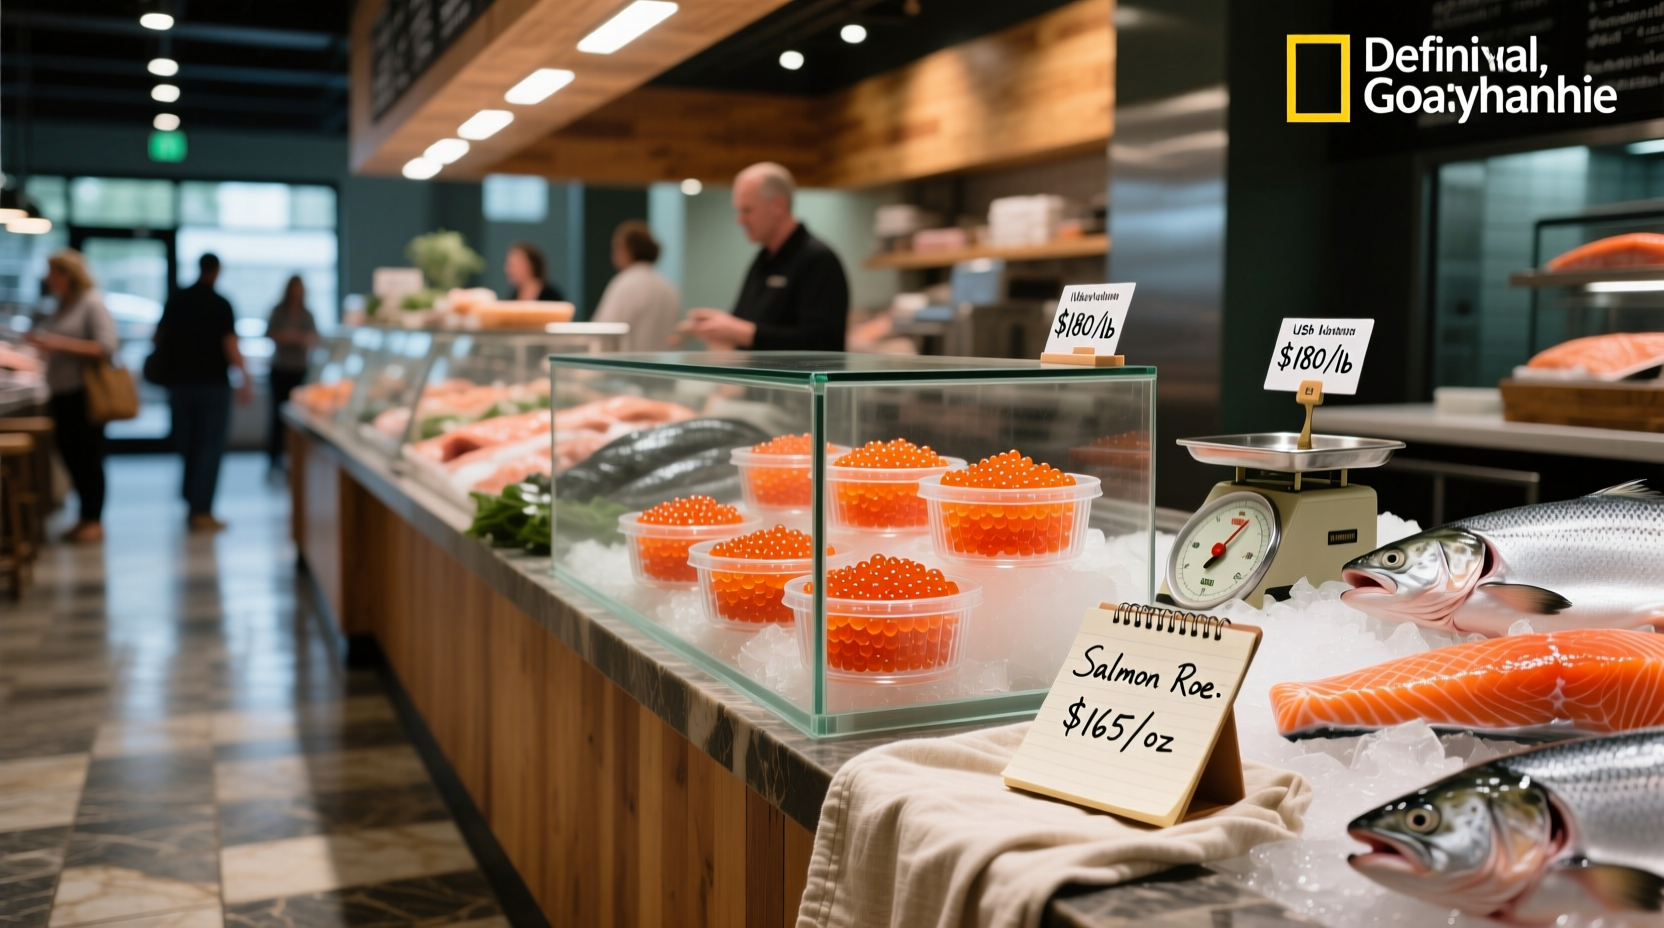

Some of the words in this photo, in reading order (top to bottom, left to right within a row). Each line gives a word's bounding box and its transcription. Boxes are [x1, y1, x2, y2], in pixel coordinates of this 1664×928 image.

[1054, 308, 1115, 339] $180/lb
[1277, 341, 1353, 374] $180/lb
[1072, 644, 1160, 690] Salmon
[1170, 662, 1222, 700] Roe.
[1062, 696, 1175, 753] $165/oz
